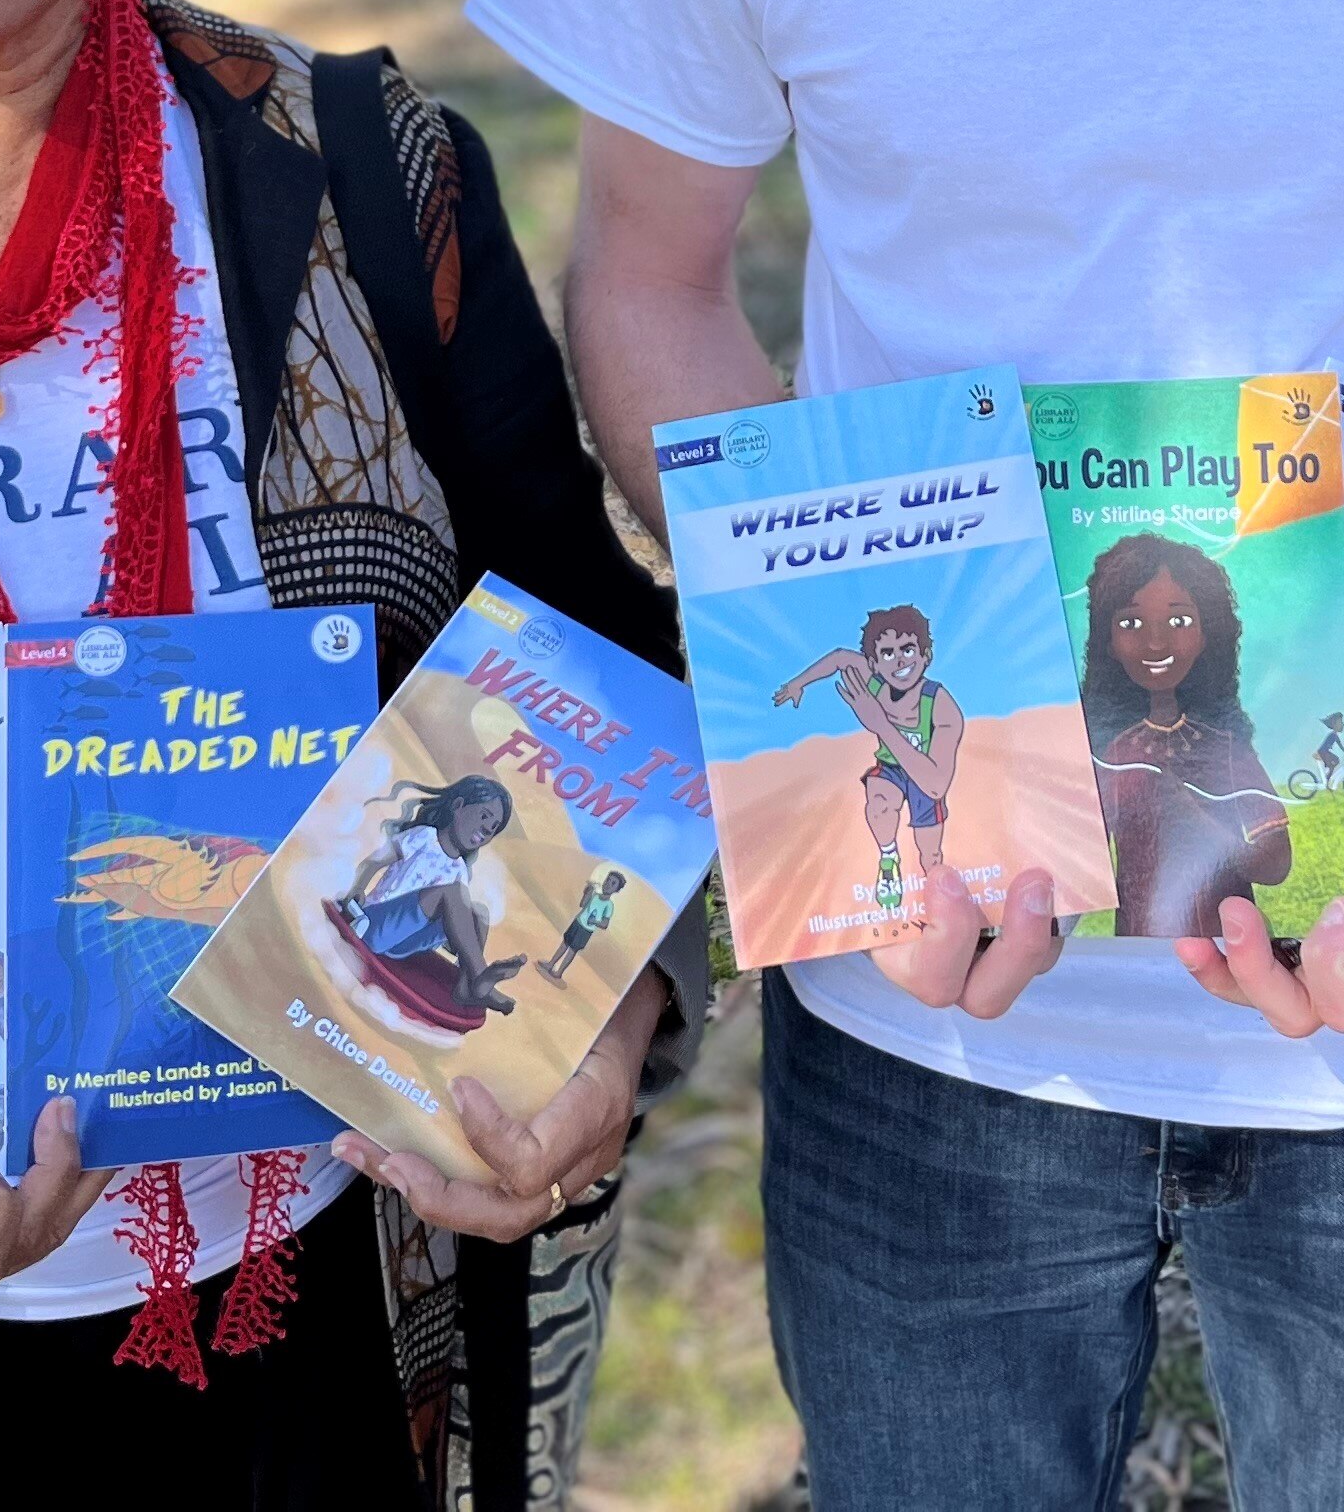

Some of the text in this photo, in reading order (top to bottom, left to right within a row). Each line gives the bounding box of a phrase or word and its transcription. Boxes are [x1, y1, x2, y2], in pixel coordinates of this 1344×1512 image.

[670, 444, 716, 463] Level 3
[1035, 442, 1320, 498] ou Can Play Too
[730, 471, 1000, 538] WHERE WILL
[1072, 504, 1242, 528] By Stirling Sharpe
[761, 511, 985, 572] YOU RUN?
[480, 597, 519, 625] Level 2
[21, 646, 68, 660] Level 4
[160, 686, 247, 729] THE
[464, 648, 633, 755] WHERE
[41, 724, 362, 778] DREADED NET
[484, 729, 639, 827] FROM
[853, 884, 875, 903] By
[809, 903, 889, 933] Illustrated
[890, 903, 908, 922] by
[46, 1073, 69, 1094] By
[75, 1068, 151, 1090] Merrilee
[156, 1061, 211, 1083] Lands
[215, 1056, 253, 1076] and
[285, 997, 440, 1115] By Chloe Daniels
[109, 1084, 194, 1109] Illustrated
[198, 1082, 223, 1102] by
[226, 1080, 277, 1099] Jason
